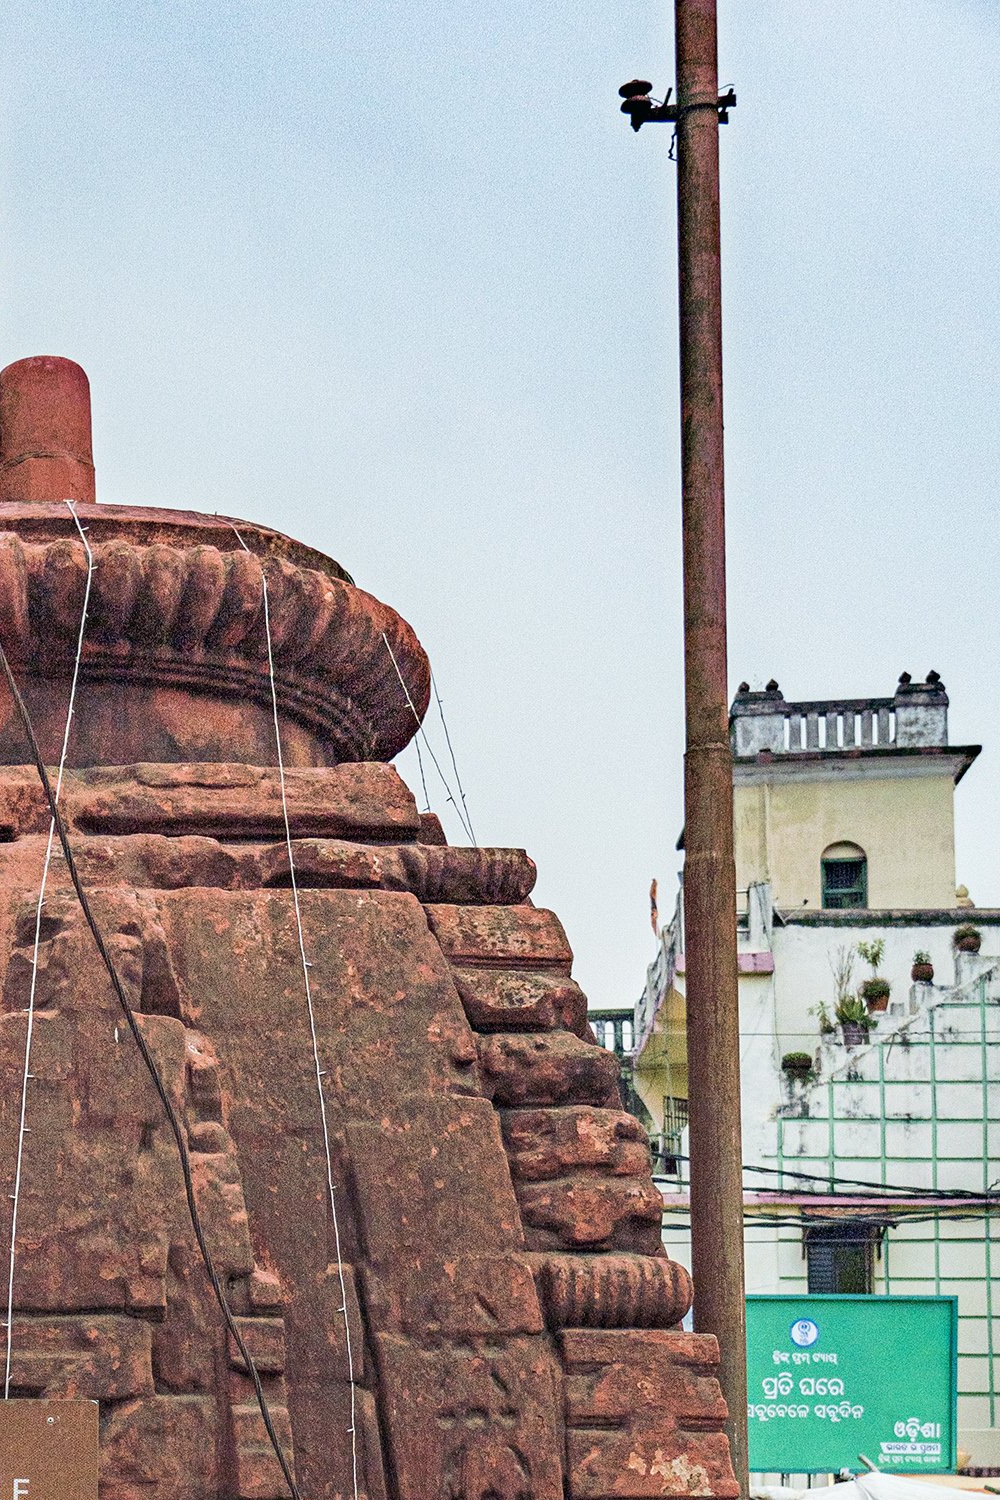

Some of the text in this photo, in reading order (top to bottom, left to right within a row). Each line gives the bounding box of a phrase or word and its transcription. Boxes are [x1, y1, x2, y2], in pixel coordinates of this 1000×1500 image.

[762, 1372, 844, 1399] ପ୍ରତି ଘରେ
[814, 1400, 864, 1422] ସବୁଦିନ
[894, 1417, 941, 1442] ଓଡ଼ିଶା
